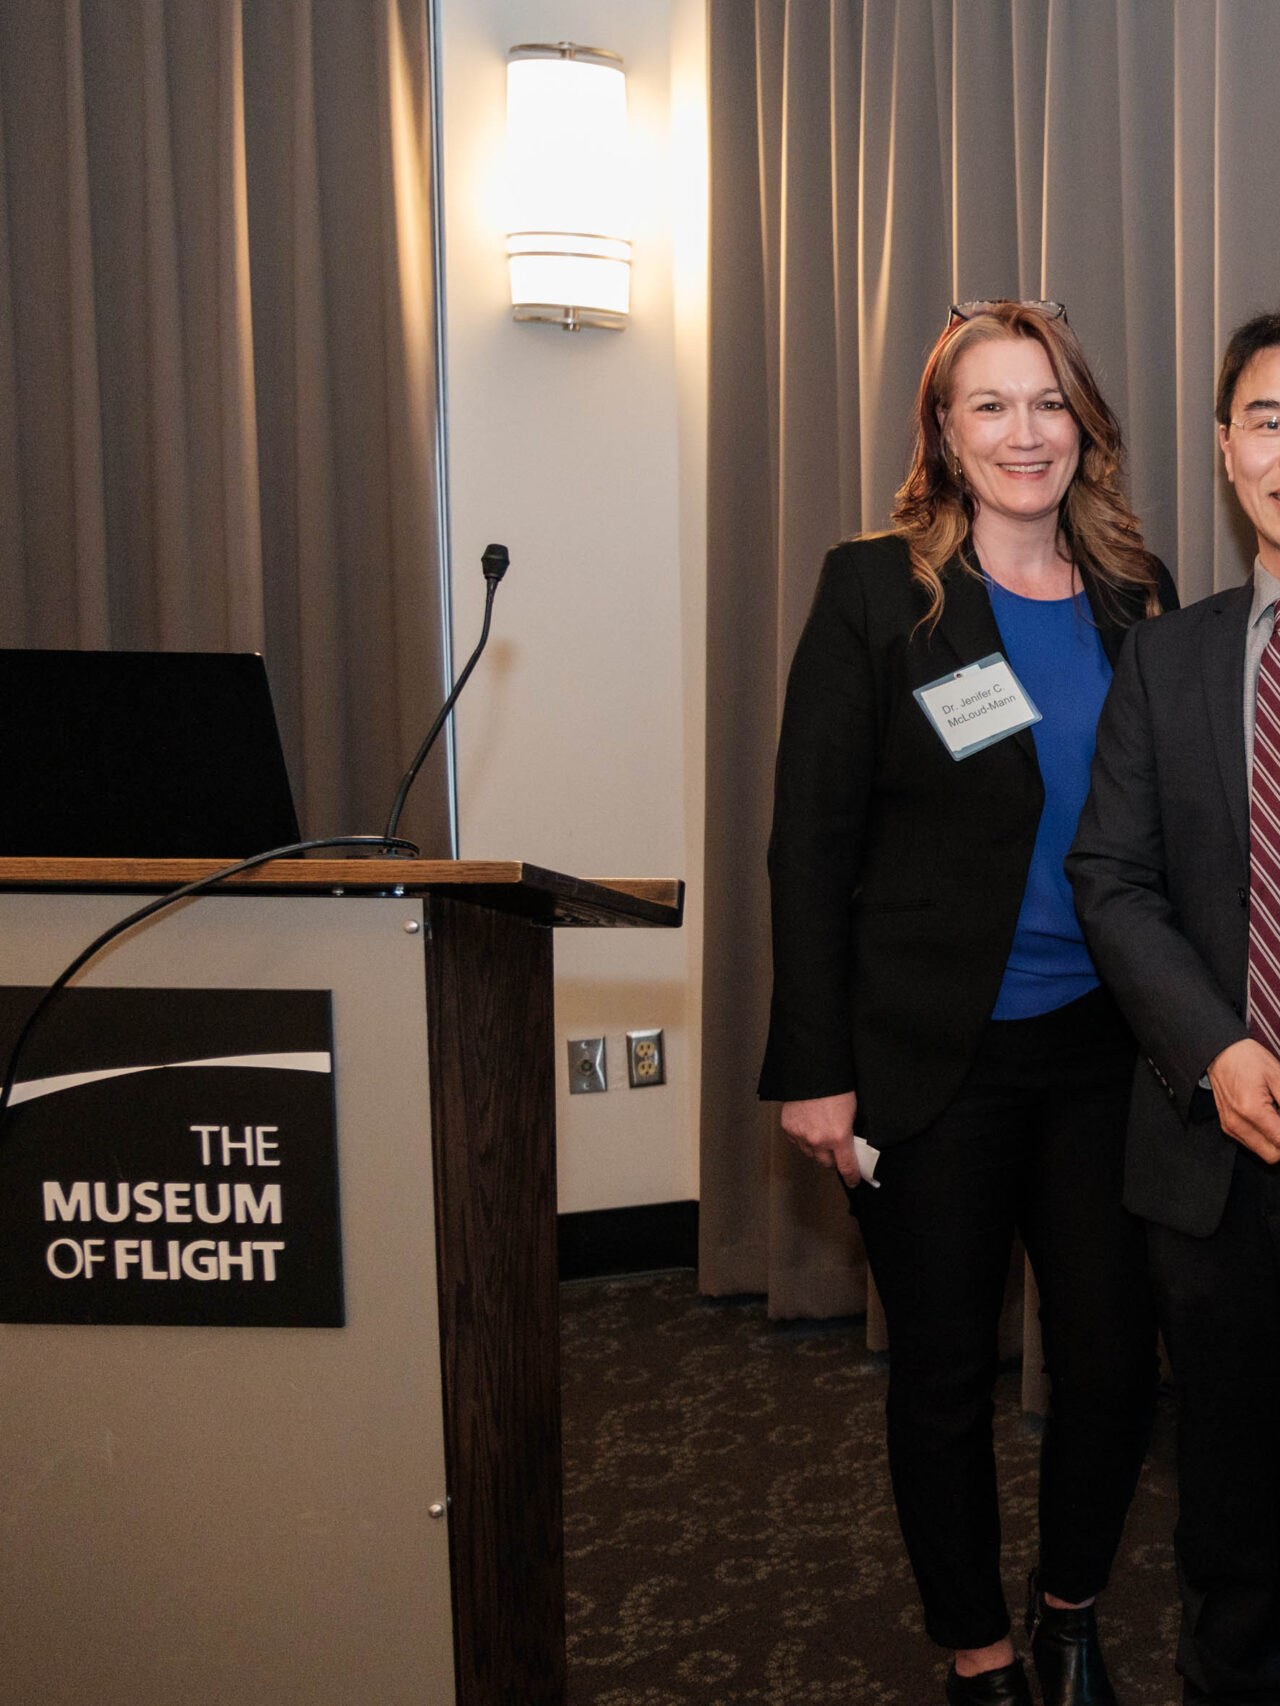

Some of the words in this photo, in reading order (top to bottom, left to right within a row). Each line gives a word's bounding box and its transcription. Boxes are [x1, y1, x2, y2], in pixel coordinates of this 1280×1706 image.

[942, 704, 959, 715] Dr.
[960, 687, 991, 708] Jenifer
[993, 683, 1006, 693] C.
[947, 694, 1017, 728] McLoud-Mann
[190, 1125, 281, 1166] THE
[42, 1181, 283, 1225] MUSEUM
[46, 1238, 106, 1280] OF
[114, 1239, 285, 1282] FLIGHT
